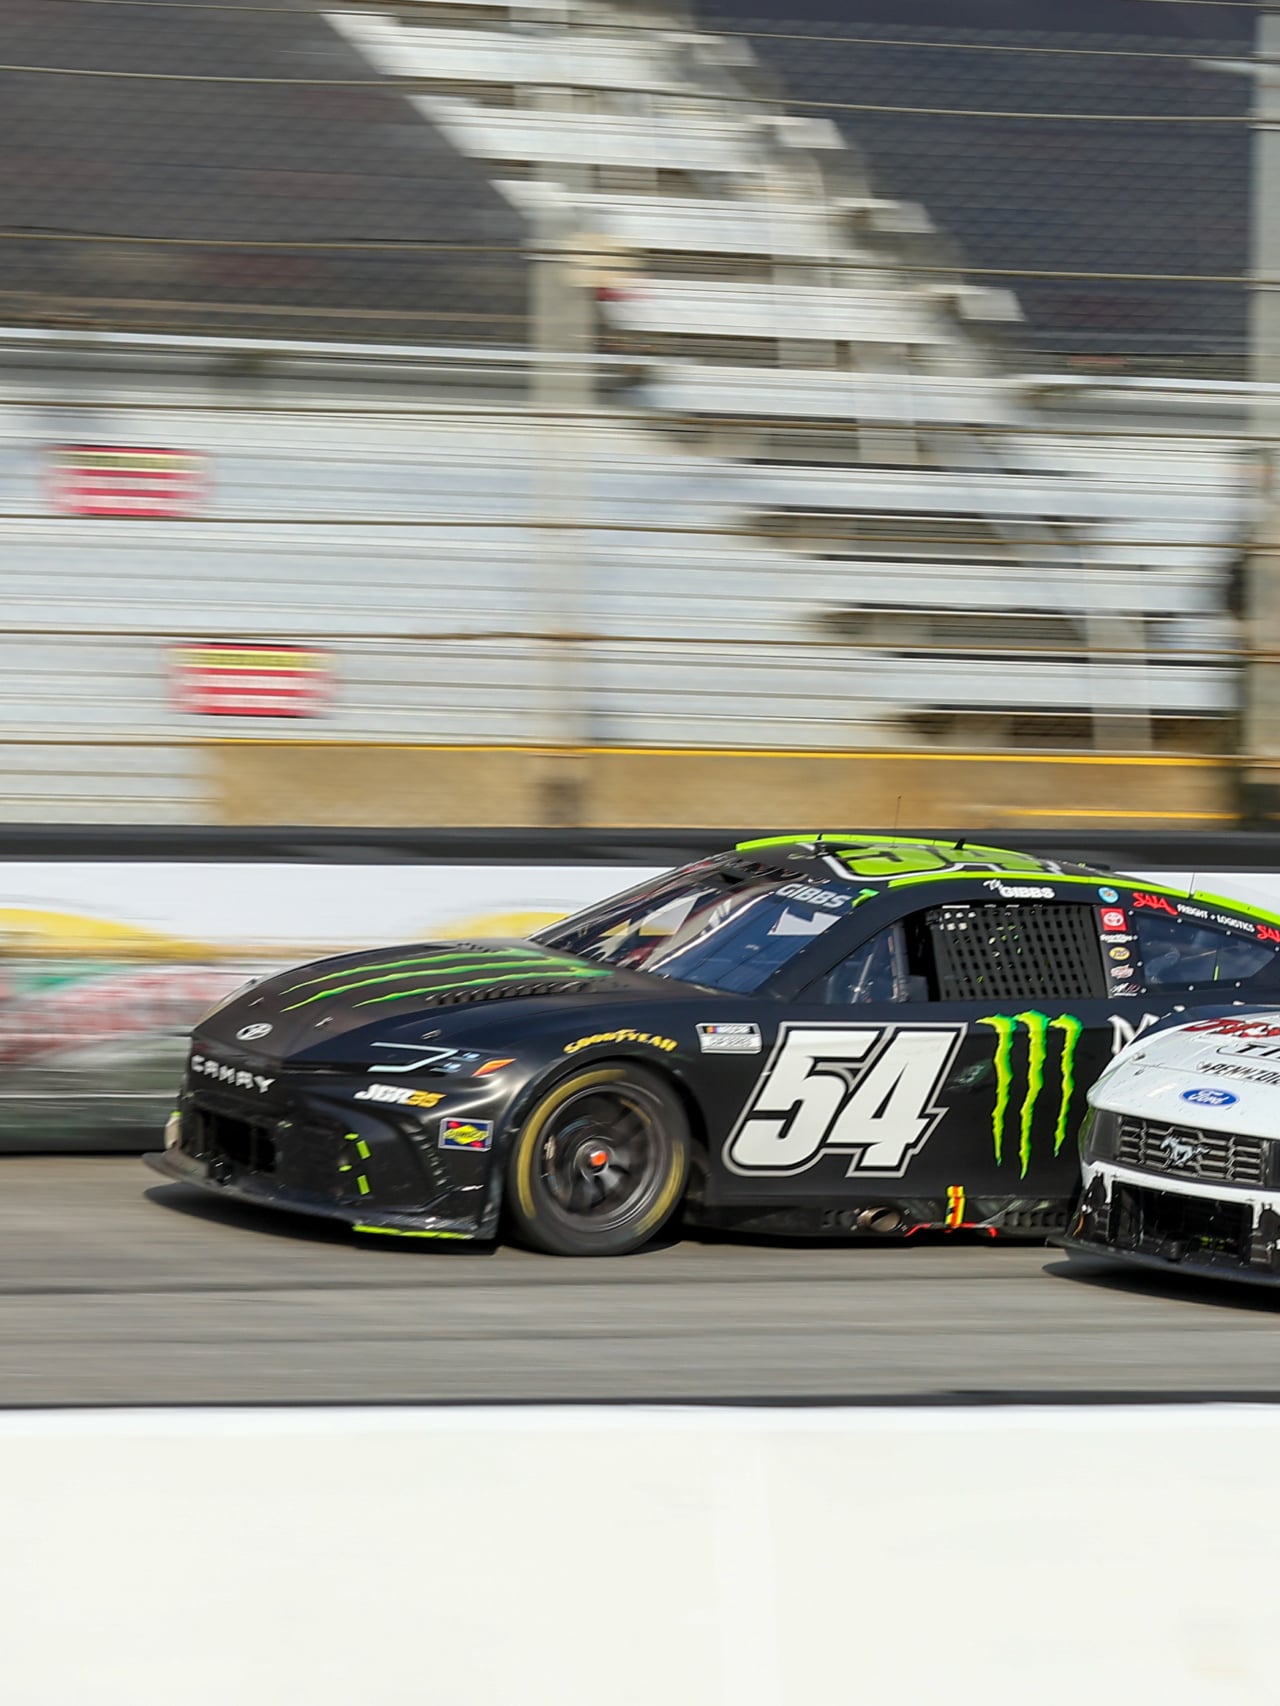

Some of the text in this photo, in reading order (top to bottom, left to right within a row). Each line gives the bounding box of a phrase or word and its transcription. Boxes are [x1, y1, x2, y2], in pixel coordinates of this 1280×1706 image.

[775, 883, 852, 908] GIBBS
[1000, 886, 1055, 899] GIBBS
[1216, 914, 1256, 933] LOGISTICS
[563, 1029, 679, 1054] GOODYEAR
[191, 1054, 277, 1094] CAMRY
[721, 1021, 968, 1178] 54
[1183, 1088, 1235, 1107] Ford
